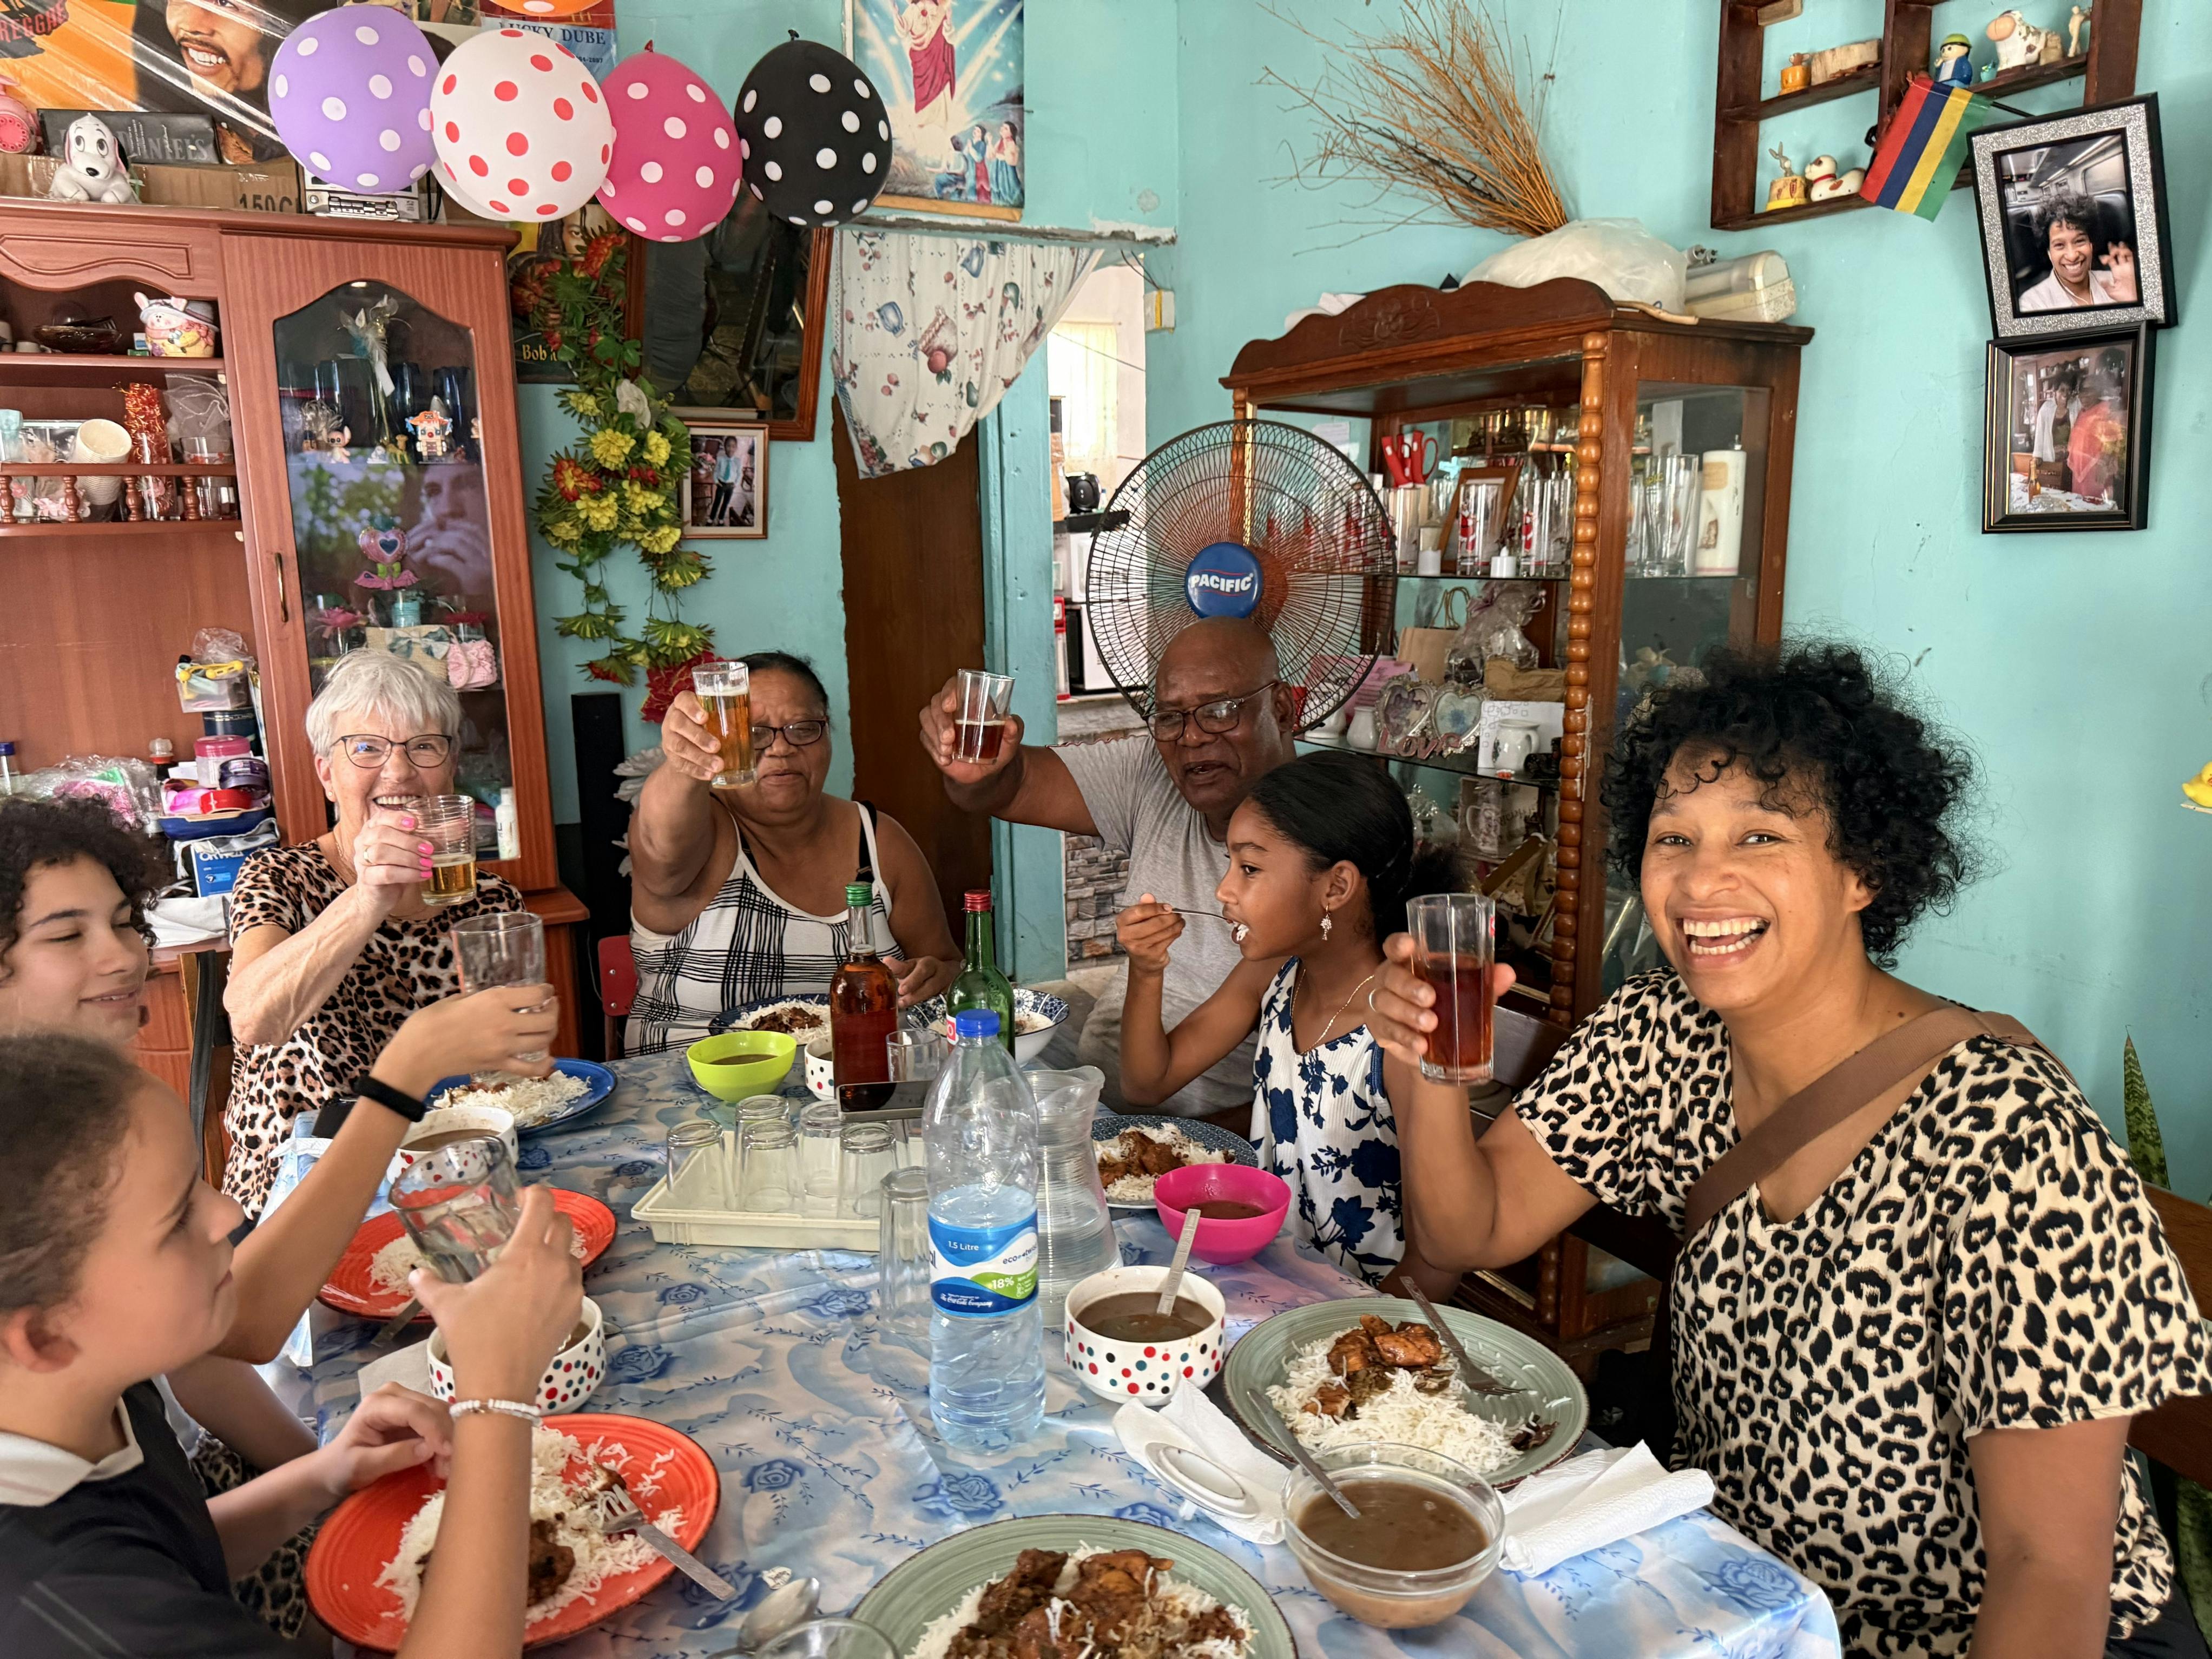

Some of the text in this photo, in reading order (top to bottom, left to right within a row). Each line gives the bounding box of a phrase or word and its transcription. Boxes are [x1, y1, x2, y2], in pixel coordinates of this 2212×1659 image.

[561, 28, 606, 45] DUBE
[522, 344, 547, 361] Bob
[1190, 574, 1252, 593] PACIFIC
[992, 1276, 1015, 1289] 18%
